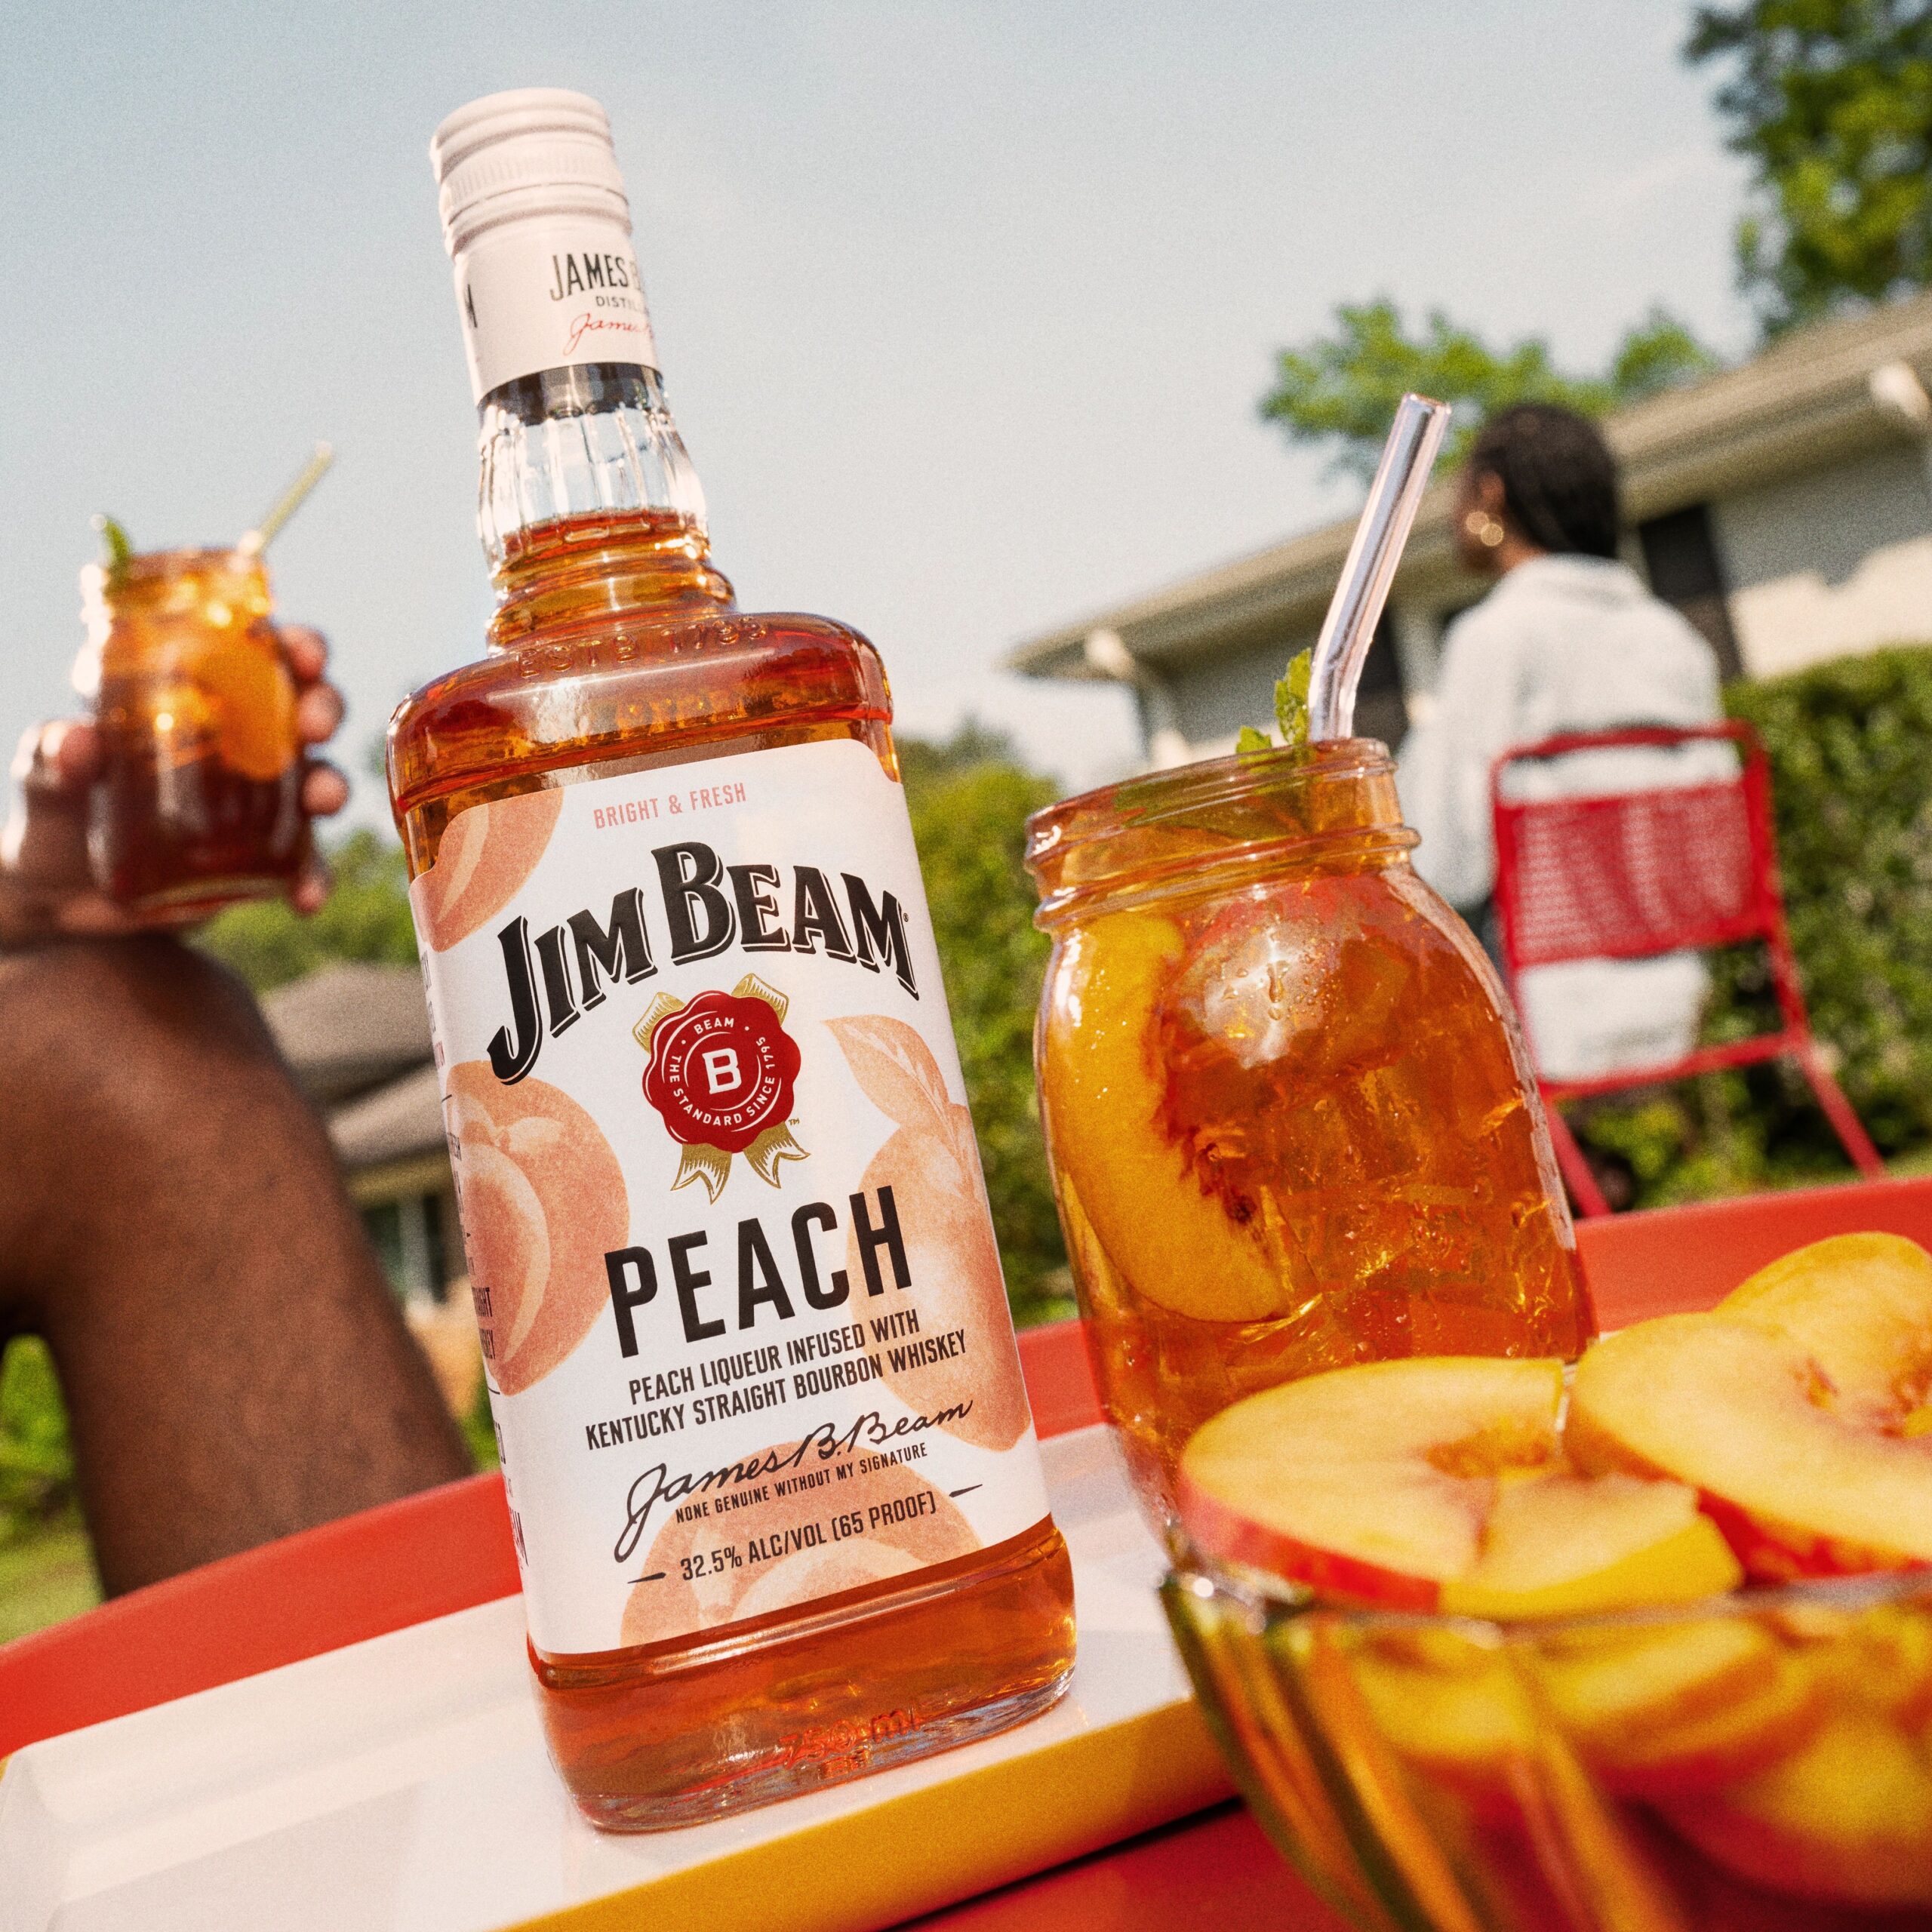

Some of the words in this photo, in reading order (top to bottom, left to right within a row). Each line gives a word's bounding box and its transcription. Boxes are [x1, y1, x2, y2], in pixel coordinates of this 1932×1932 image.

[549, 254, 628, 301] JAMES
[593, 798, 659, 829] BRIGHT
[669, 794, 683, 815] &
[689, 783, 746, 811] FRESH
[487, 887, 658, 1086] JIM
[694, 1017, 734, 1035] BEAM
[669, 1055, 681, 1083] THE
[702, 1048, 742, 1094] B
[756, 1036, 775, 1069] 1795
[673, 1088, 743, 1126] STANDARD
[746, 1077, 775, 1116] SINCE
[605, 1185, 912, 1358] PEACH
[629, 1367, 695, 1404] PEACH
[700, 1345, 783, 1388] LIQUEUR
[786, 1324, 866, 1366] INFUSED
[870, 1309, 921, 1343] WITH
[585, 1404, 686, 1451] KENTUCKY
[694, 1379, 786, 1425] STRAIGHT
[794, 1358, 884, 1399] BOURBON
[887, 1329, 966, 1374] WHISKEY
[614, 1451, 789, 1564] James
[846, 1399, 974, 1452] Beam
[675, 1499, 709, 1524] NONE
[715, 1489, 770, 1515] GENUINE
[774, 1469, 831, 1497] WITHOUT
[836, 1461, 854, 1481] MY
[860, 1442, 928, 1475] SIGNATURE
[680, 1546, 743, 1581] 32.5%
[748, 1521, 827, 1564] ALC/VOL
